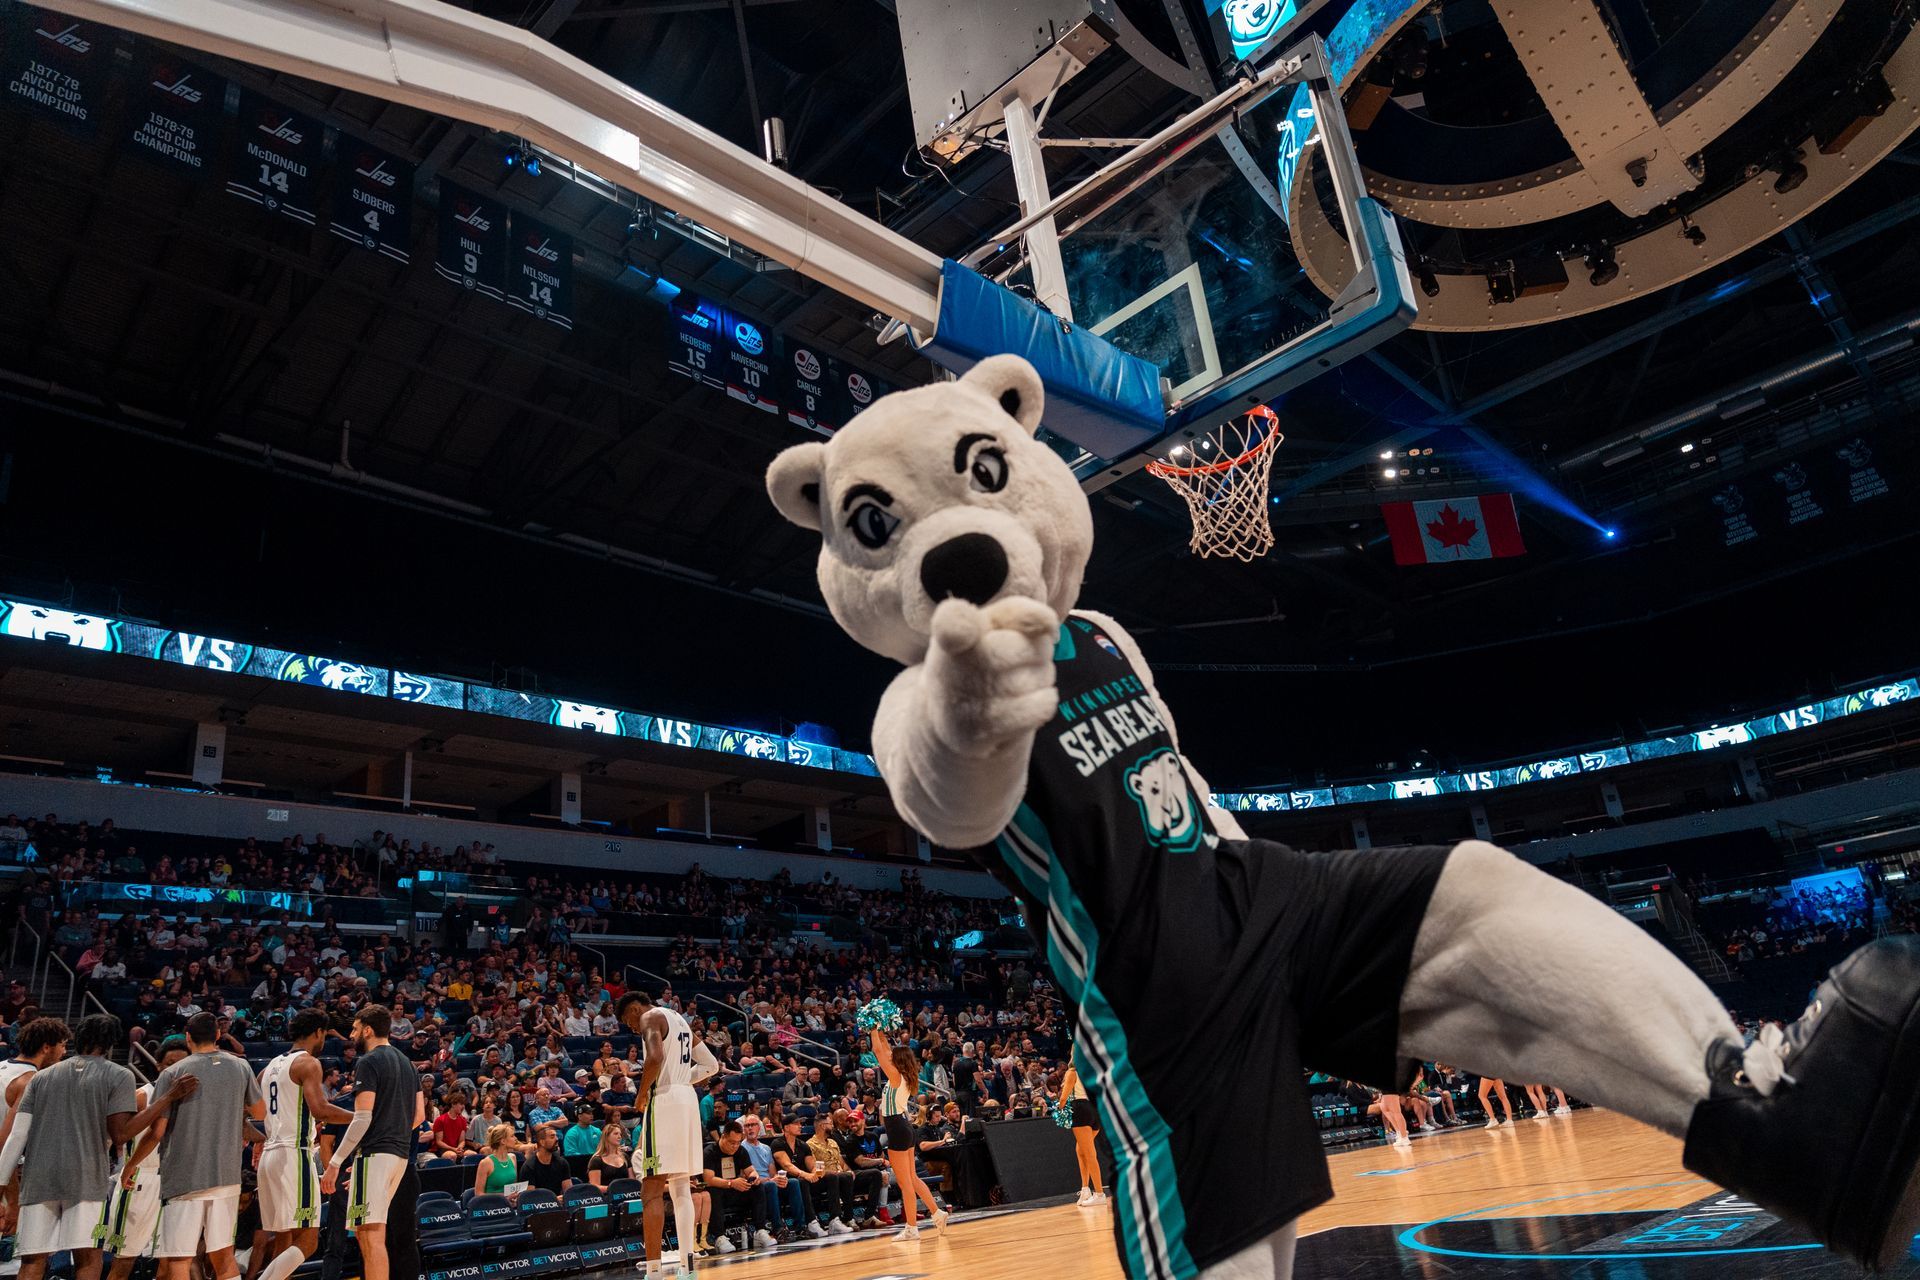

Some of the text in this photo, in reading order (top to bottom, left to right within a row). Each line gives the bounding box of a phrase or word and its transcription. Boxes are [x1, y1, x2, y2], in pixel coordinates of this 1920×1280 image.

[28, 60, 81, 91] 1977-78
[21, 70, 82, 104] AVCO CUP
[9, 80, 88, 121] CHAMPIONS
[149, 111, 195, 139] 1978-79
[142, 122, 197, 152] AVCO CUP
[132, 130, 203, 168] CHAMPIONS
[247, 142, 308, 178] McDONALD
[258, 164, 289, 194] 14
[352, 188, 396, 215] SJOBERG
[363, 210, 380, 232] 4
[460, 236, 483, 255] HULL
[463, 253, 478, 274] 9
[523, 264, 560, 289] NILSSON
[529, 281, 553, 307] 14
[679, 332, 712, 354] HEDBERG
[687, 348, 706, 370] 15
[742, 366, 761, 388] 10
[796, 379, 822, 397] CARLYLE
[805, 394, 816, 412] 8
[178, 632, 236, 671] VS
[1779, 704, 1820, 731] VS
[655, 717, 692, 748] VS
[203, 746, 216, 757] 35
[1462, 771, 1494, 792] VS
[266, 808, 289, 822] 218
[604, 840, 622, 853] 219
[677, 1031, 691, 1065] 13
[269, 1080, 278, 1116] 8
[521, 1201, 559, 1212] BETVICTOR
[568, 1196, 604, 1208] BETVICTOR
[612, 1190, 642, 1201] BETVICTO
[420, 1212, 462, 1225] BETVICTOR
[472, 1206, 512, 1218] BETVICTOR
[532, 1252, 578, 1266] BETVICTOR
[581, 1245, 626, 1260] BETVICTOR
[429, 1266, 480, 1280] BETVICTOR
[483, 1259, 530, 1274] BETVICTOR
